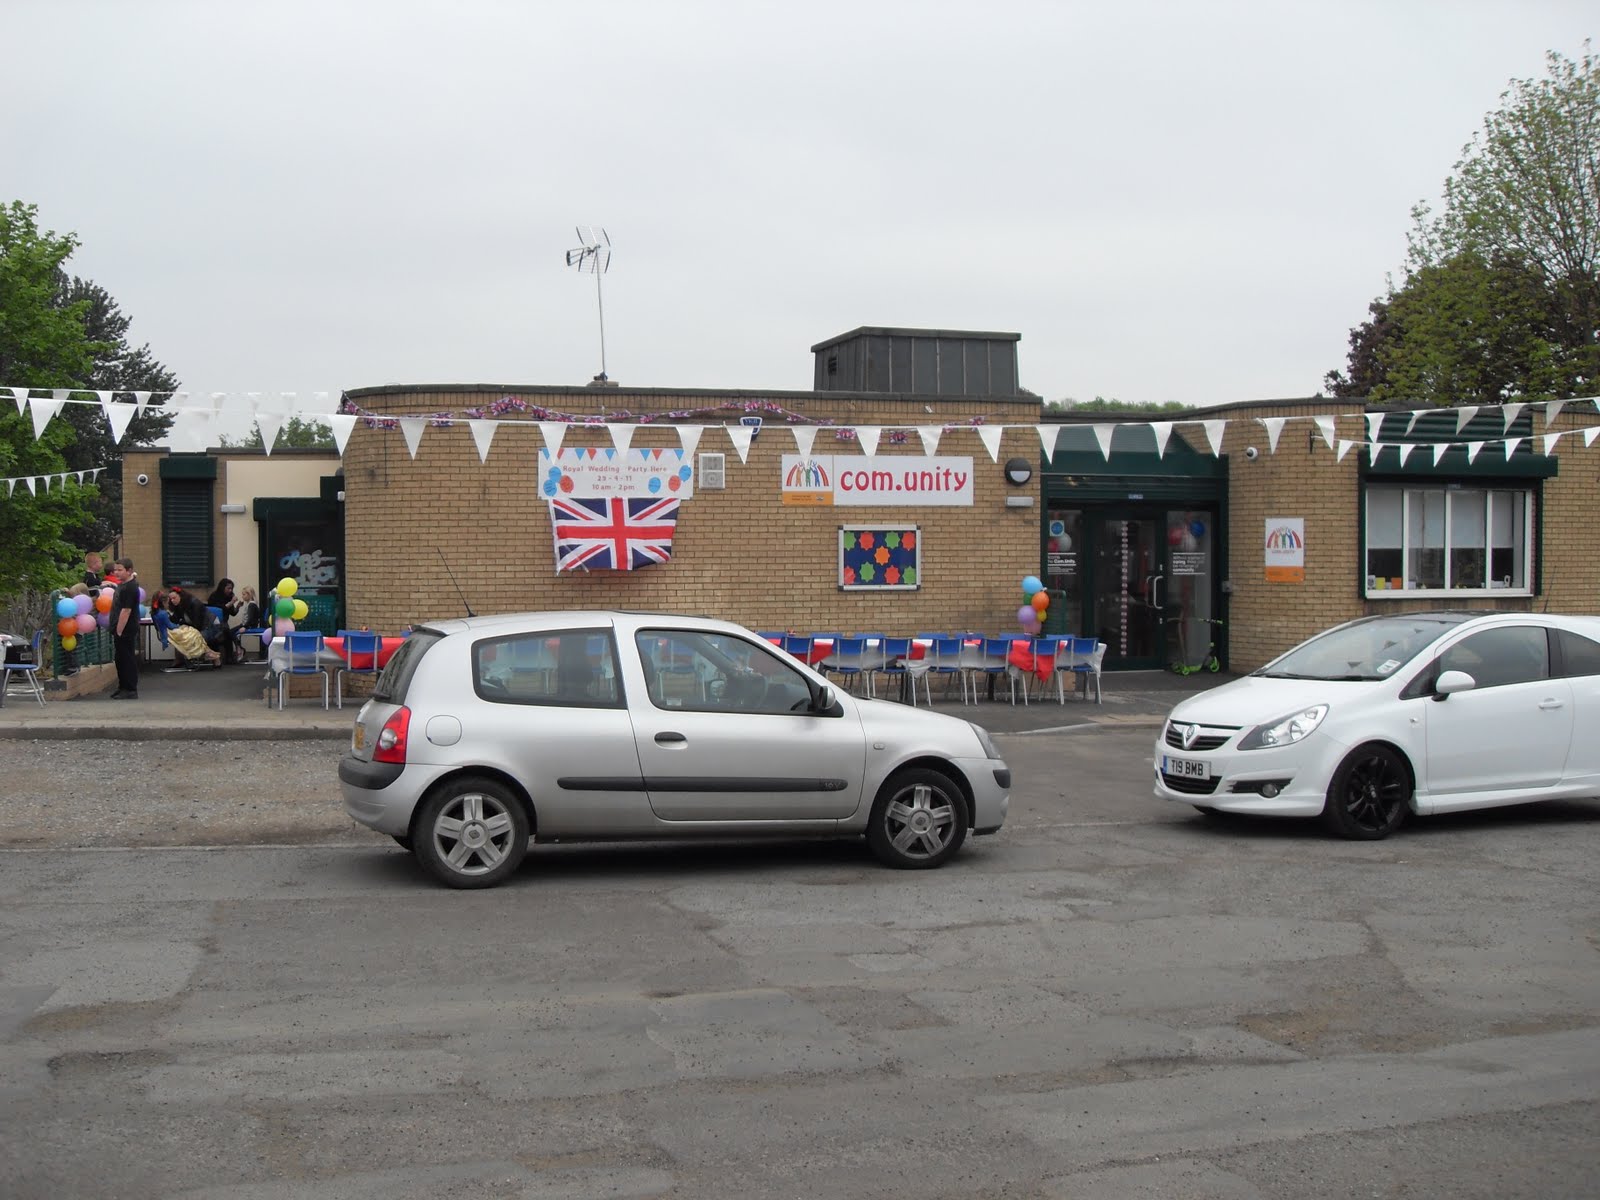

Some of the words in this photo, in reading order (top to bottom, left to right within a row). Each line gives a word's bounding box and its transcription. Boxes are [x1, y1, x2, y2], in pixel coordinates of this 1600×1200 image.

[562, 465, 584, 473] Royal
[588, 465, 620, 473] Wedding
[627, 465, 648, 473] Party
[840, 466, 967, 491] com.unity
[1171, 759, 1183, 774] T19
[1185, 761, 1204, 776] BMB
